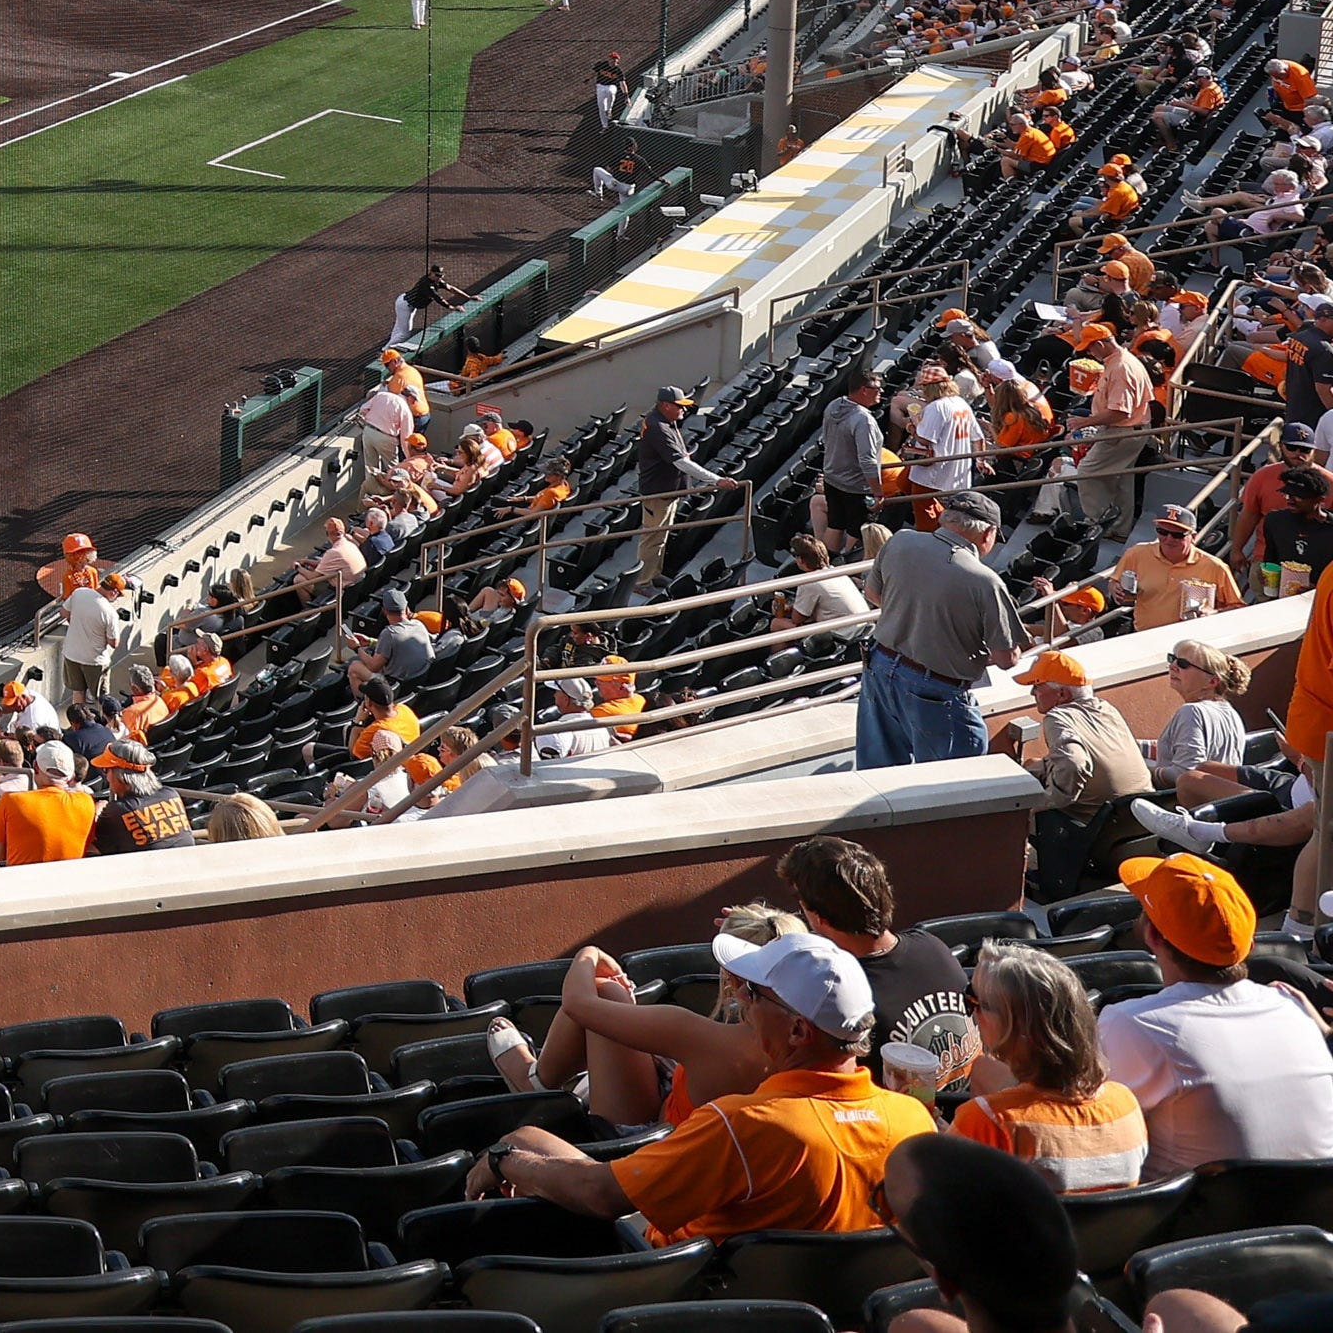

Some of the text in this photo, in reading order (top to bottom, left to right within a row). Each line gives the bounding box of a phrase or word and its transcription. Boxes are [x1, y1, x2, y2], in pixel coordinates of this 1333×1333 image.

[1073, 368, 1088, 386] T
[1166, 506, 1182, 521] T
[74, 535, 87, 547] T
[121, 795, 187, 832] EVENT
